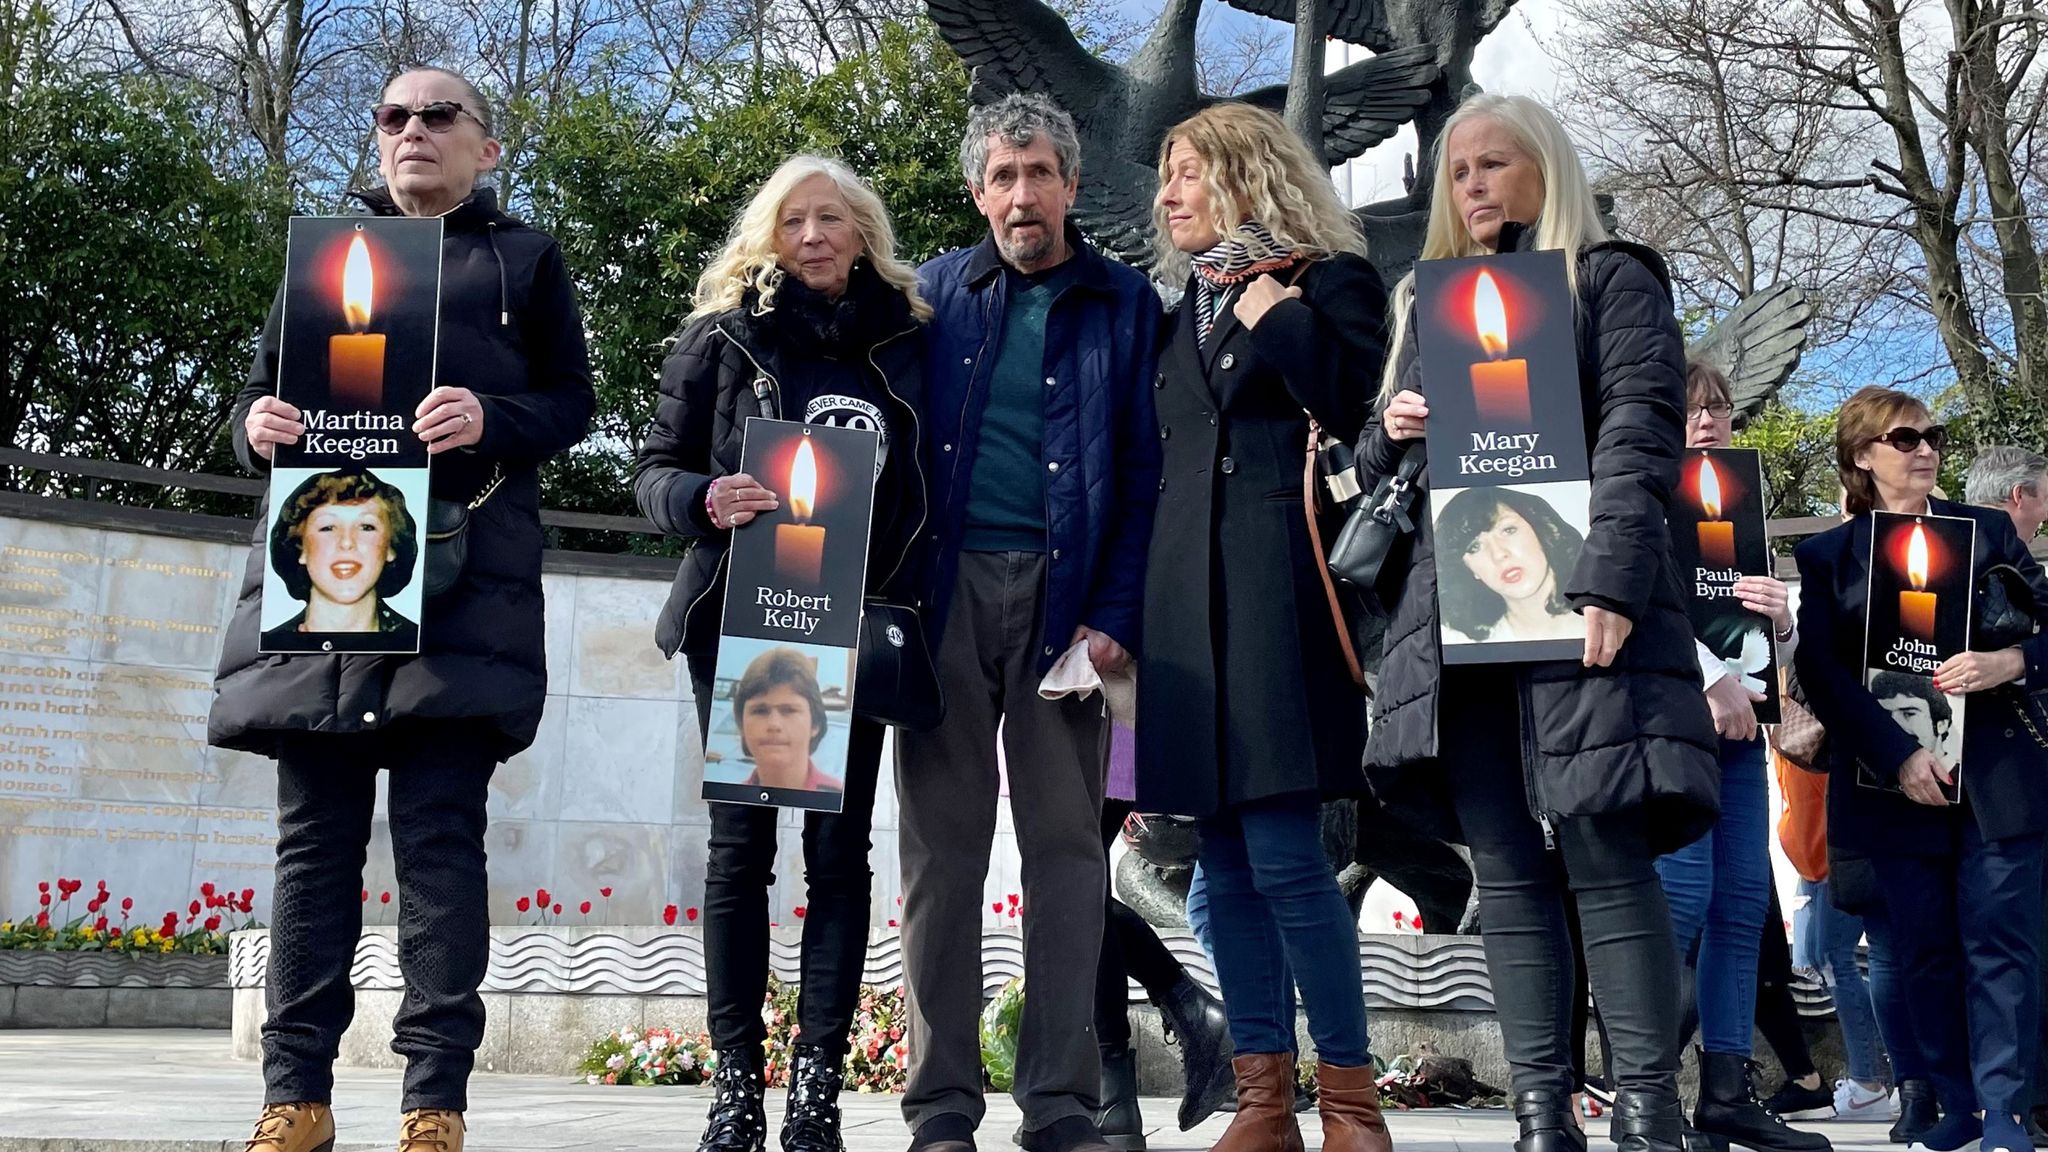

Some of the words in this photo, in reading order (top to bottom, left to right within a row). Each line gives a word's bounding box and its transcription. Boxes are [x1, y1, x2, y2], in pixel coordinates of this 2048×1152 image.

[806, 397, 838, 417] NEVER
[839, 398, 874, 413] CAME
[302, 409, 405, 430] Martina
[303, 433, 399, 460] Keegan
[1470, 431, 1540, 454] Mary
[1459, 454, 1557, 477] Keegan
[1695, 567, 1743, 582] Paula
[755, 586, 831, 612] Robert
[1695, 582, 1738, 600] Byrn
[763, 608, 820, 635] Kelly
[1892, 637, 1938, 656] John
[1885, 651, 1943, 672] Colgan
